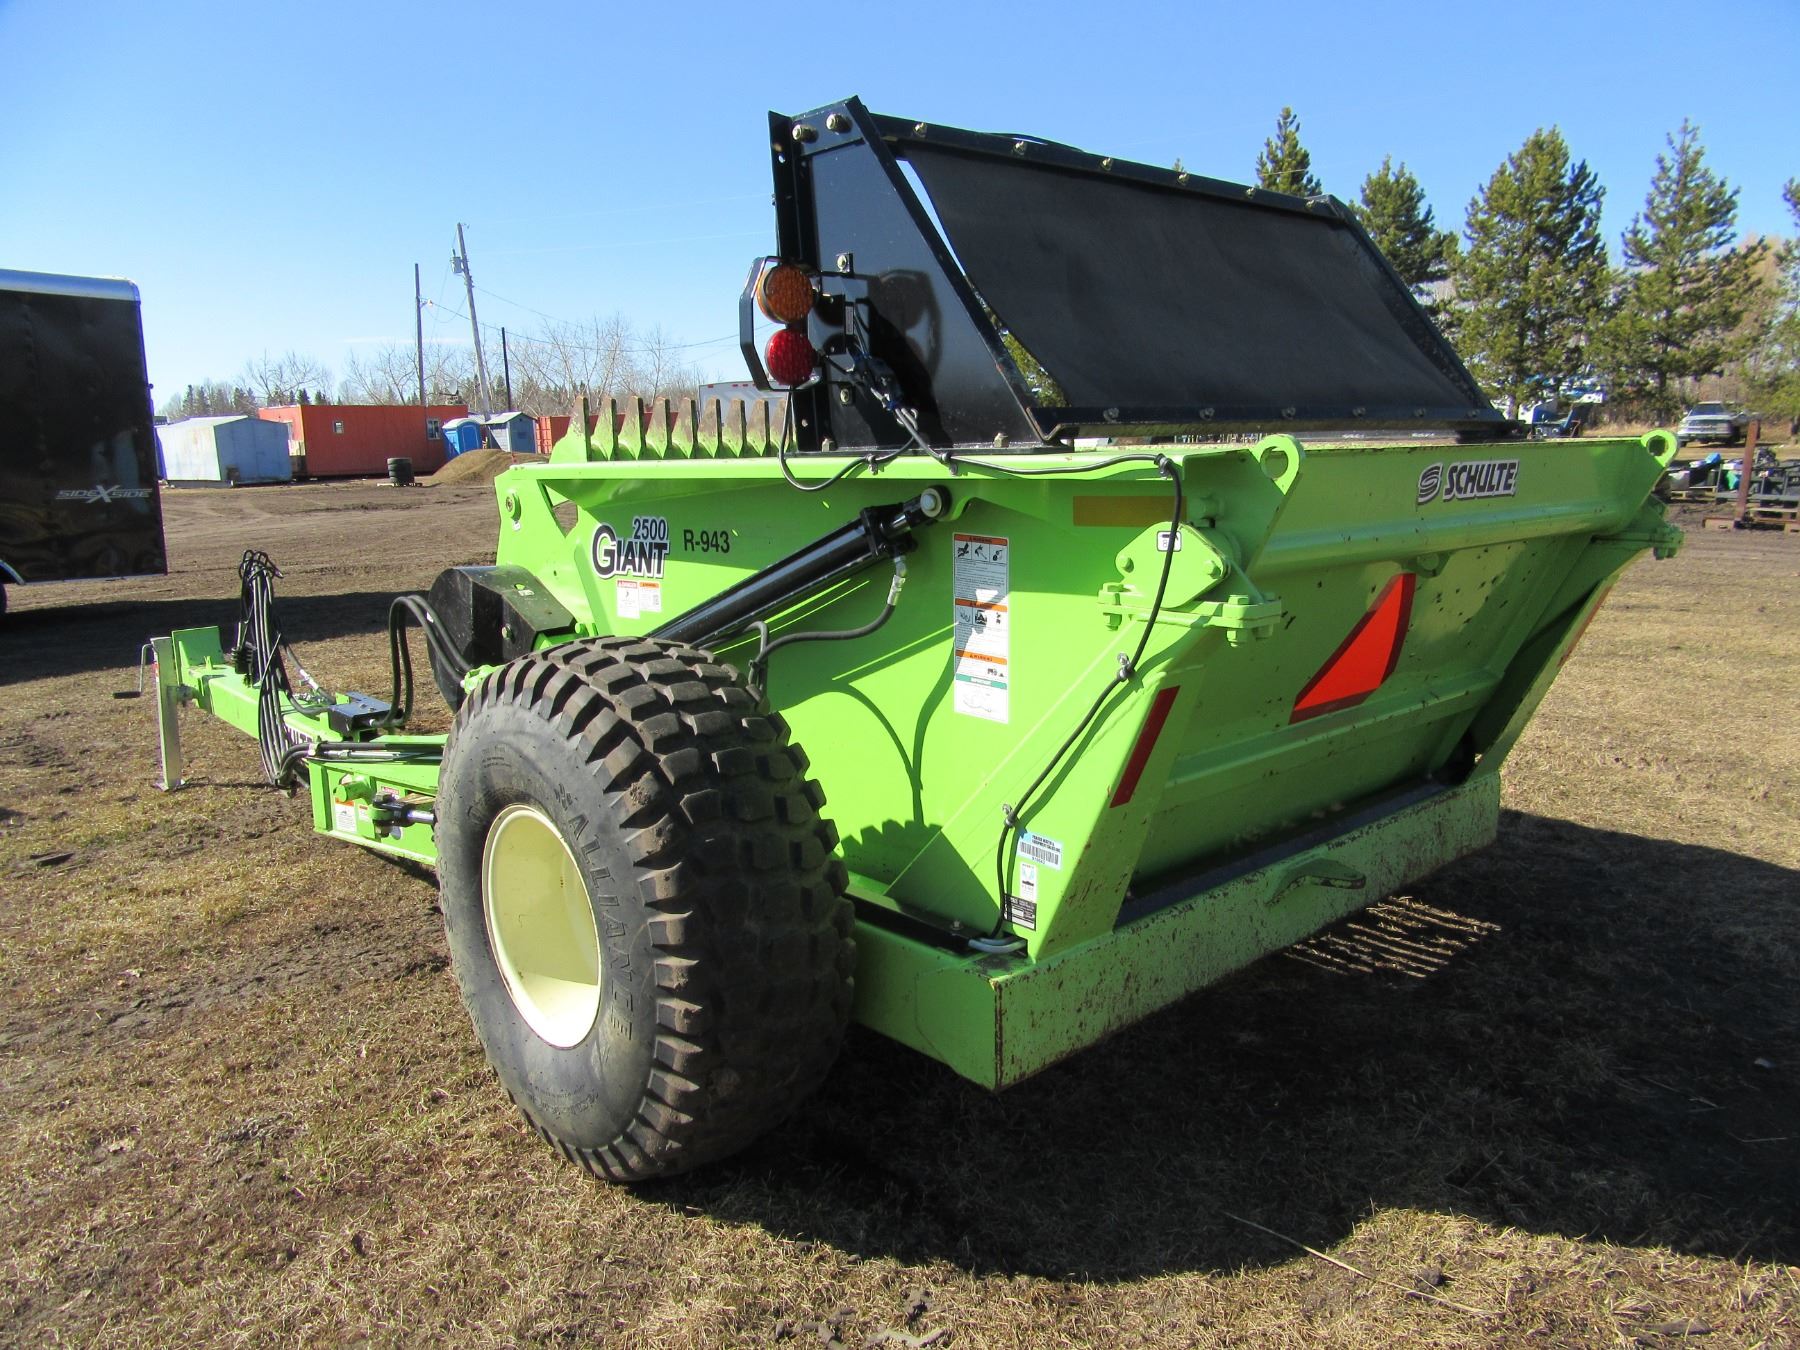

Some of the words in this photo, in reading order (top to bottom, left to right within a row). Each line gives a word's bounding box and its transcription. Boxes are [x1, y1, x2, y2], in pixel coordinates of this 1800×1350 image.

[1444, 462, 1517, 497] SCHULTE
[633, 518, 667, 541] 2500
[683, 528, 731, 554] R-943
[592, 524, 669, 578] GIANT
[567, 812, 633, 1041] ALLIANCE
